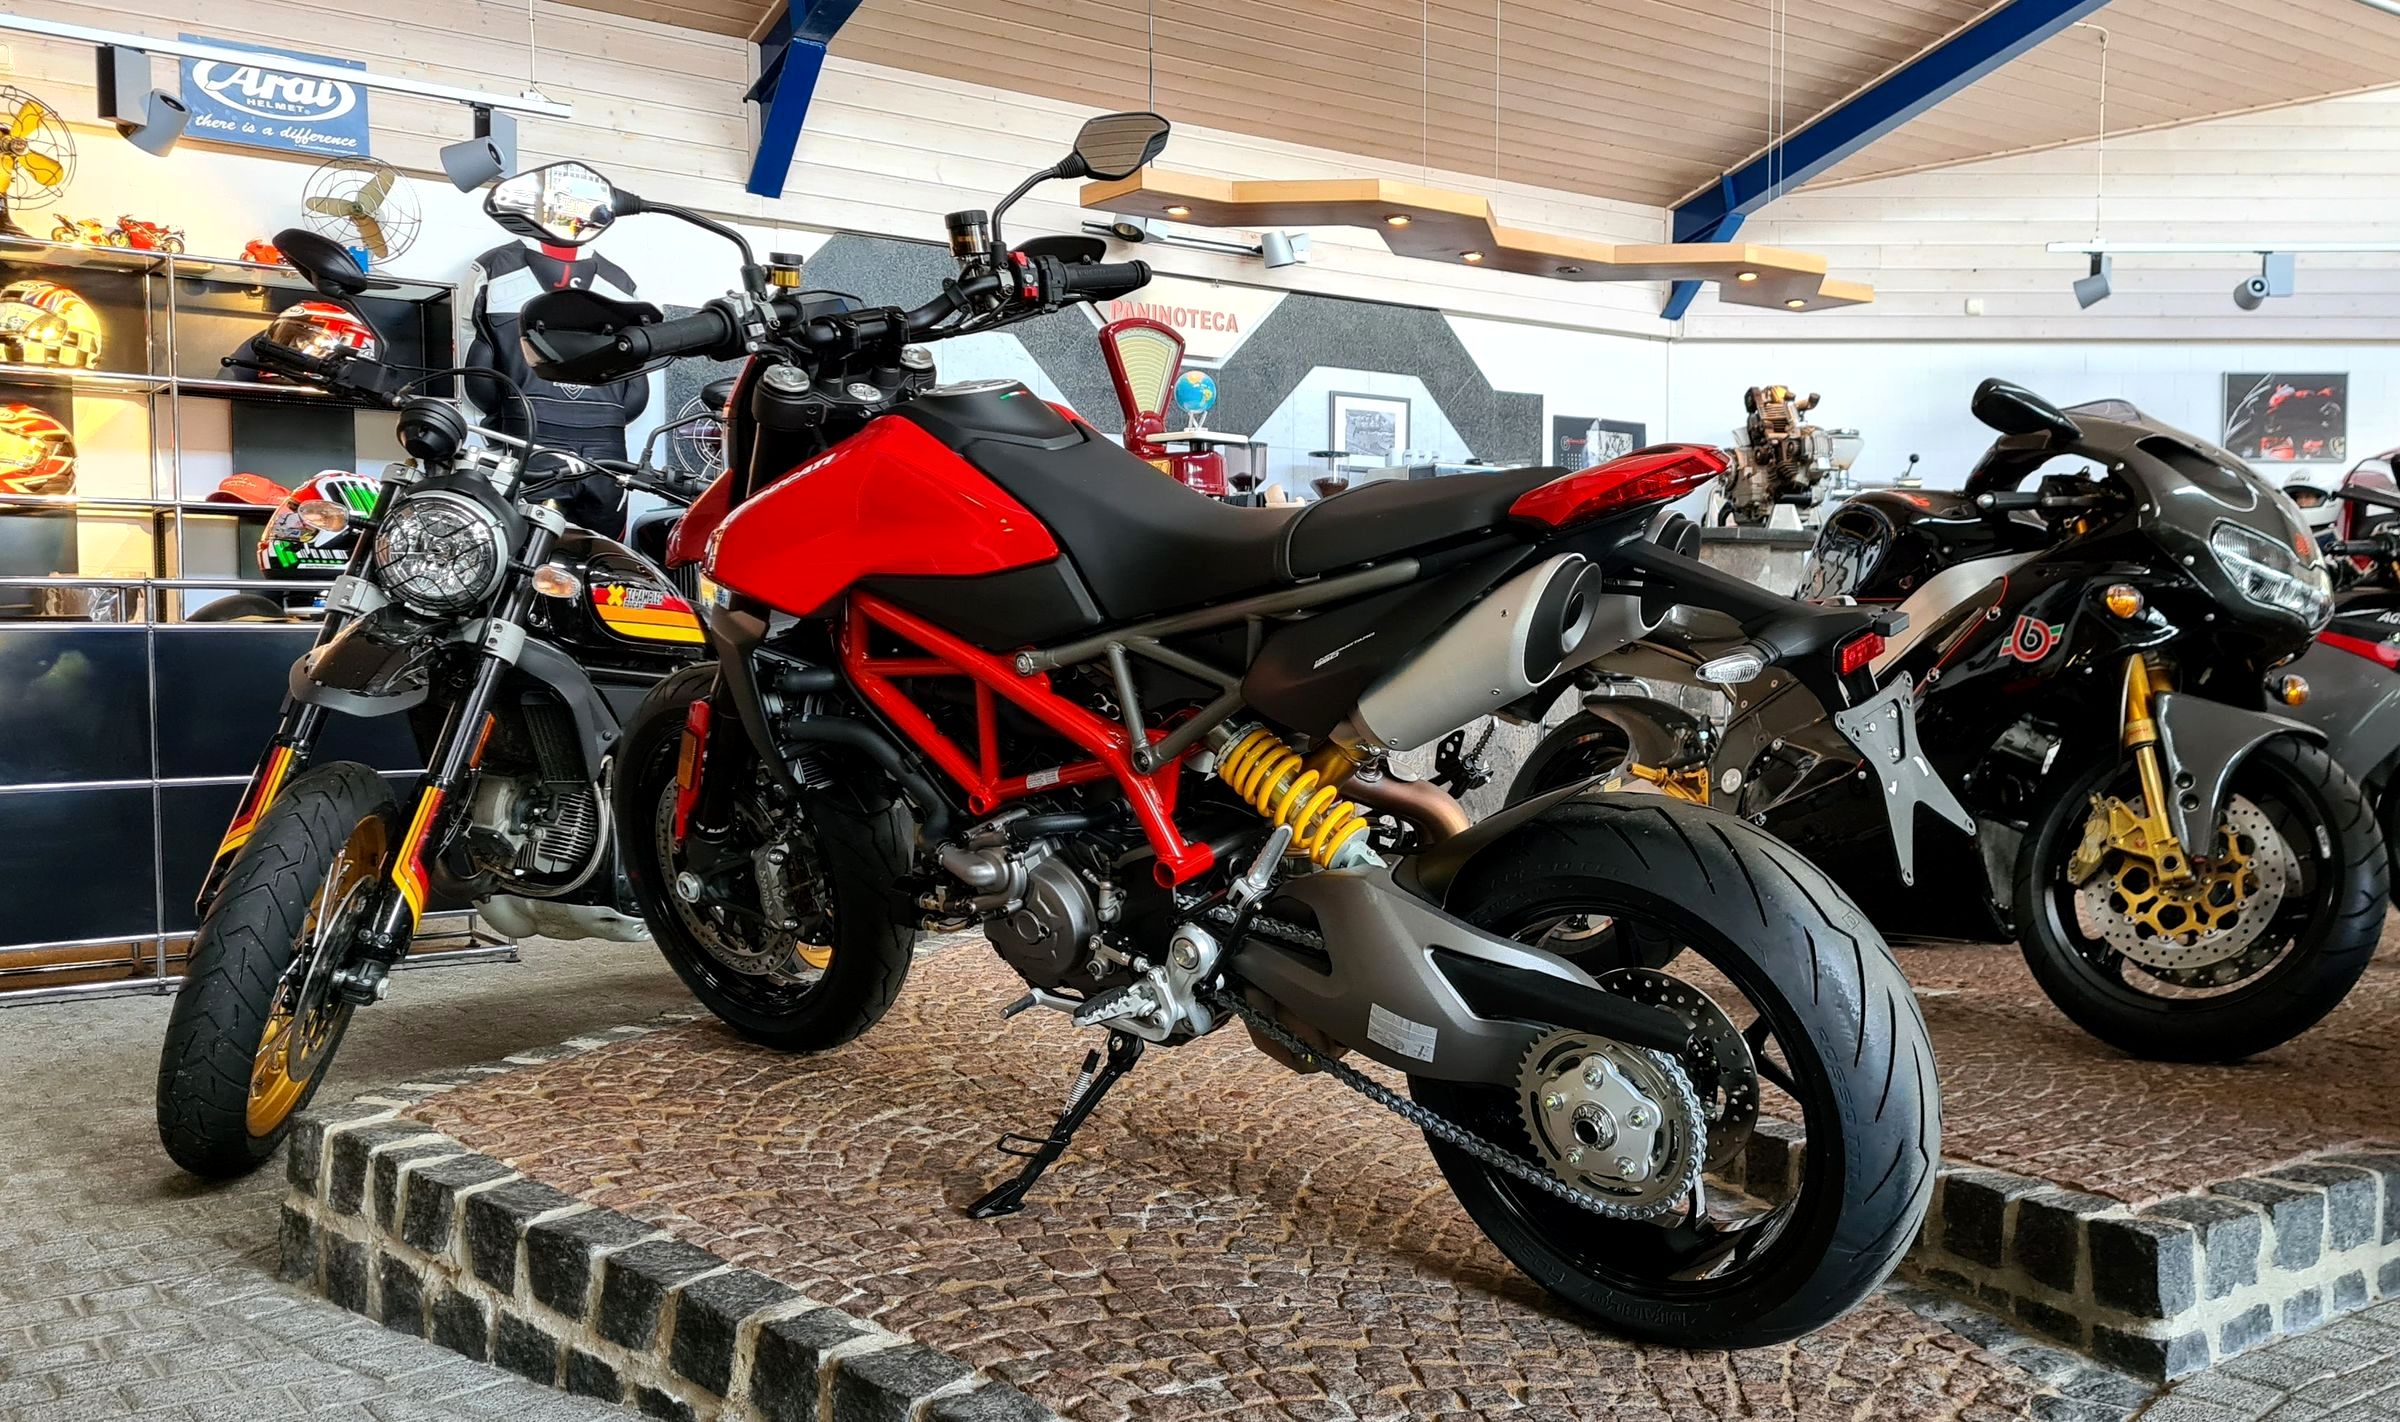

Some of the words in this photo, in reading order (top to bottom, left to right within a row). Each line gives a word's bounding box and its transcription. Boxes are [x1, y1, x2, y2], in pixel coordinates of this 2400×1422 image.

[205, 66, 337, 108] Arai
[247, 98, 305, 113] HELMET
[194, 112, 237, 131] there
[241, 120, 257, 134] is
[262, 124, 274, 136] a
[279, 126, 358, 148] difference
[1111, 300, 1239, 333] PANINOTECA
